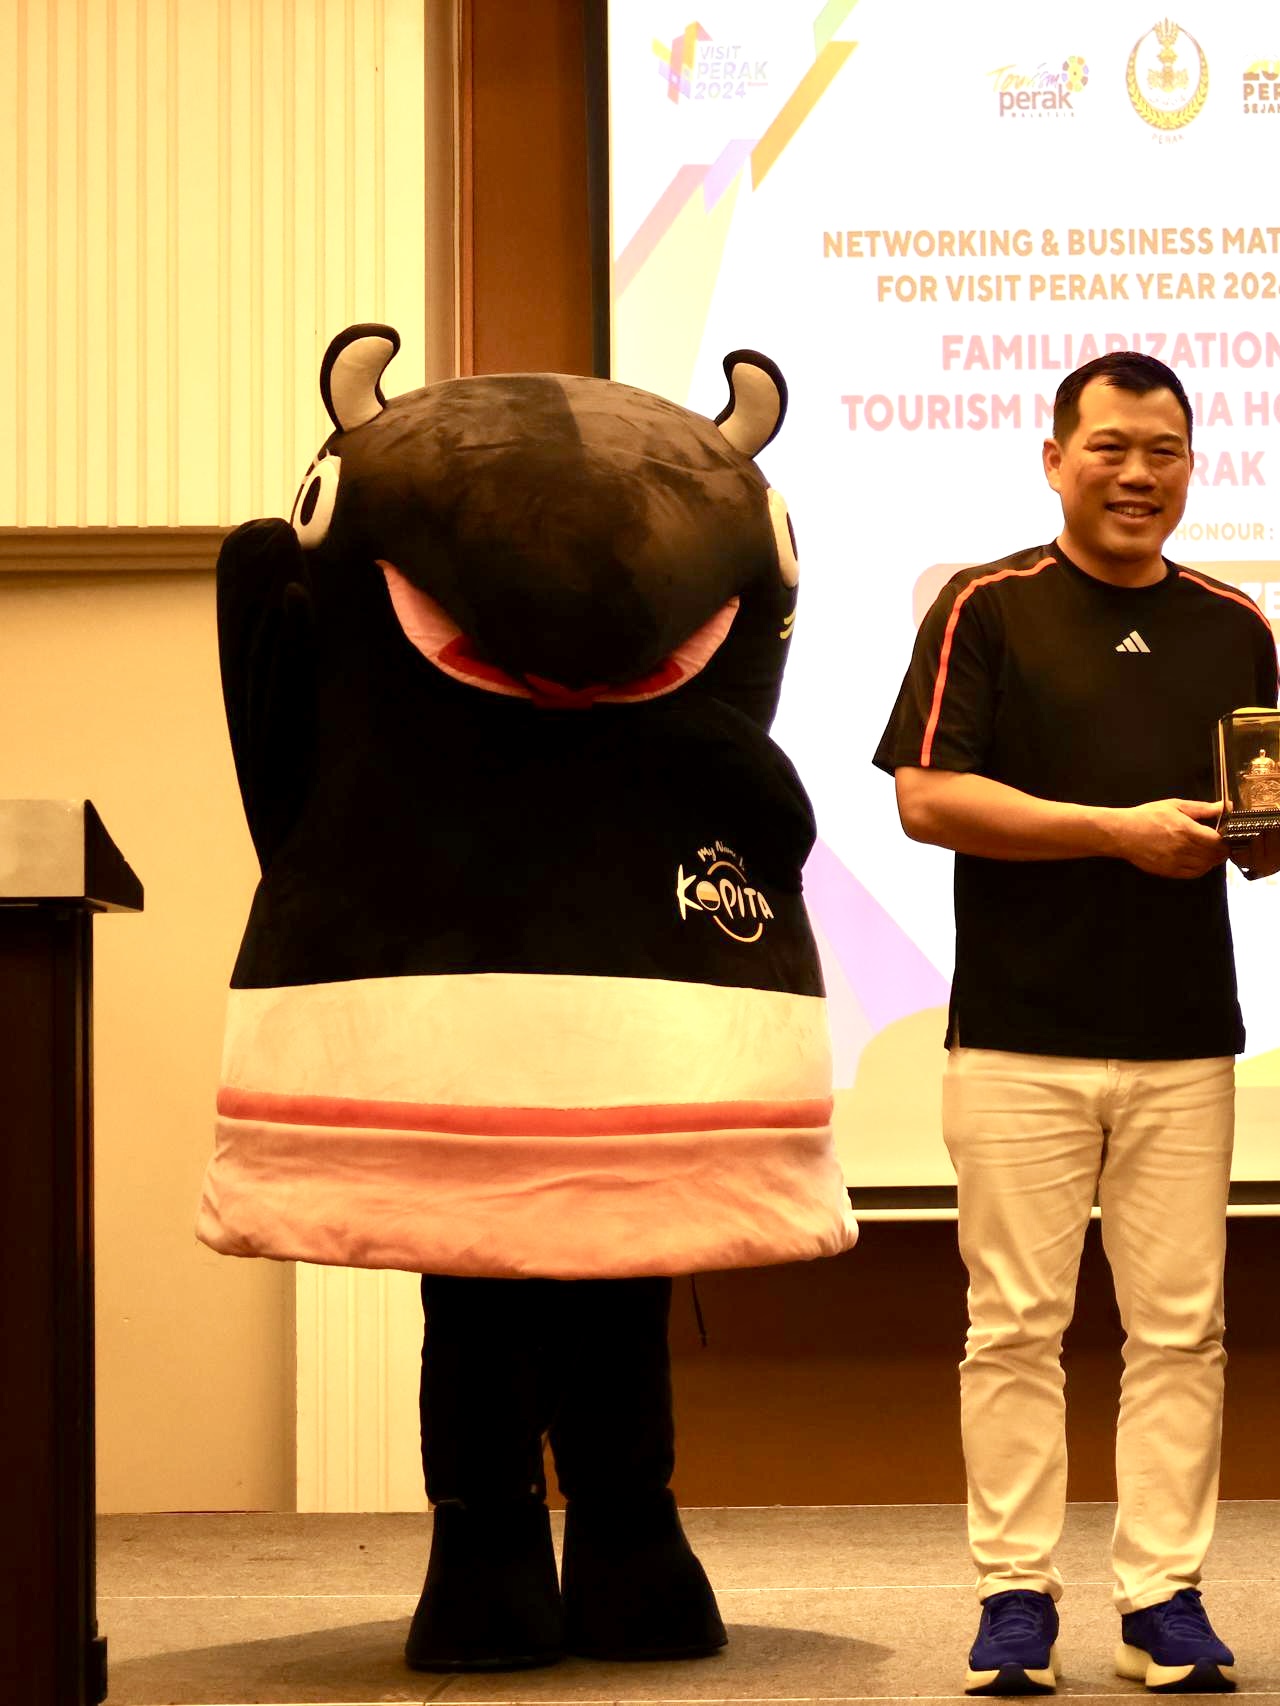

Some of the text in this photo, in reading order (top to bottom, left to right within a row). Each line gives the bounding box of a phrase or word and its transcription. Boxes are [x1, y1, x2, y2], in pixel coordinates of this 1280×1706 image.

[700, 44, 742, 60] VISIT
[697, 61, 768, 80] PERAK
[695, 81, 746, 100] 2024
[999, 83, 1073, 118] perak
[823, 229, 1034, 258] NETWORKING
[1041, 228, 1060, 257] &
[1067, 227, 1214, 256] BUSINESS
[877, 274, 938, 303] FOR
[945, 274, 1022, 303] VISIT
[1029, 273, 1129, 301] PERAK
[1136, 272, 1216, 300] YEAR
[841, 393, 1021, 431] TOURISM
[677, 863, 774, 921] KOPITA
